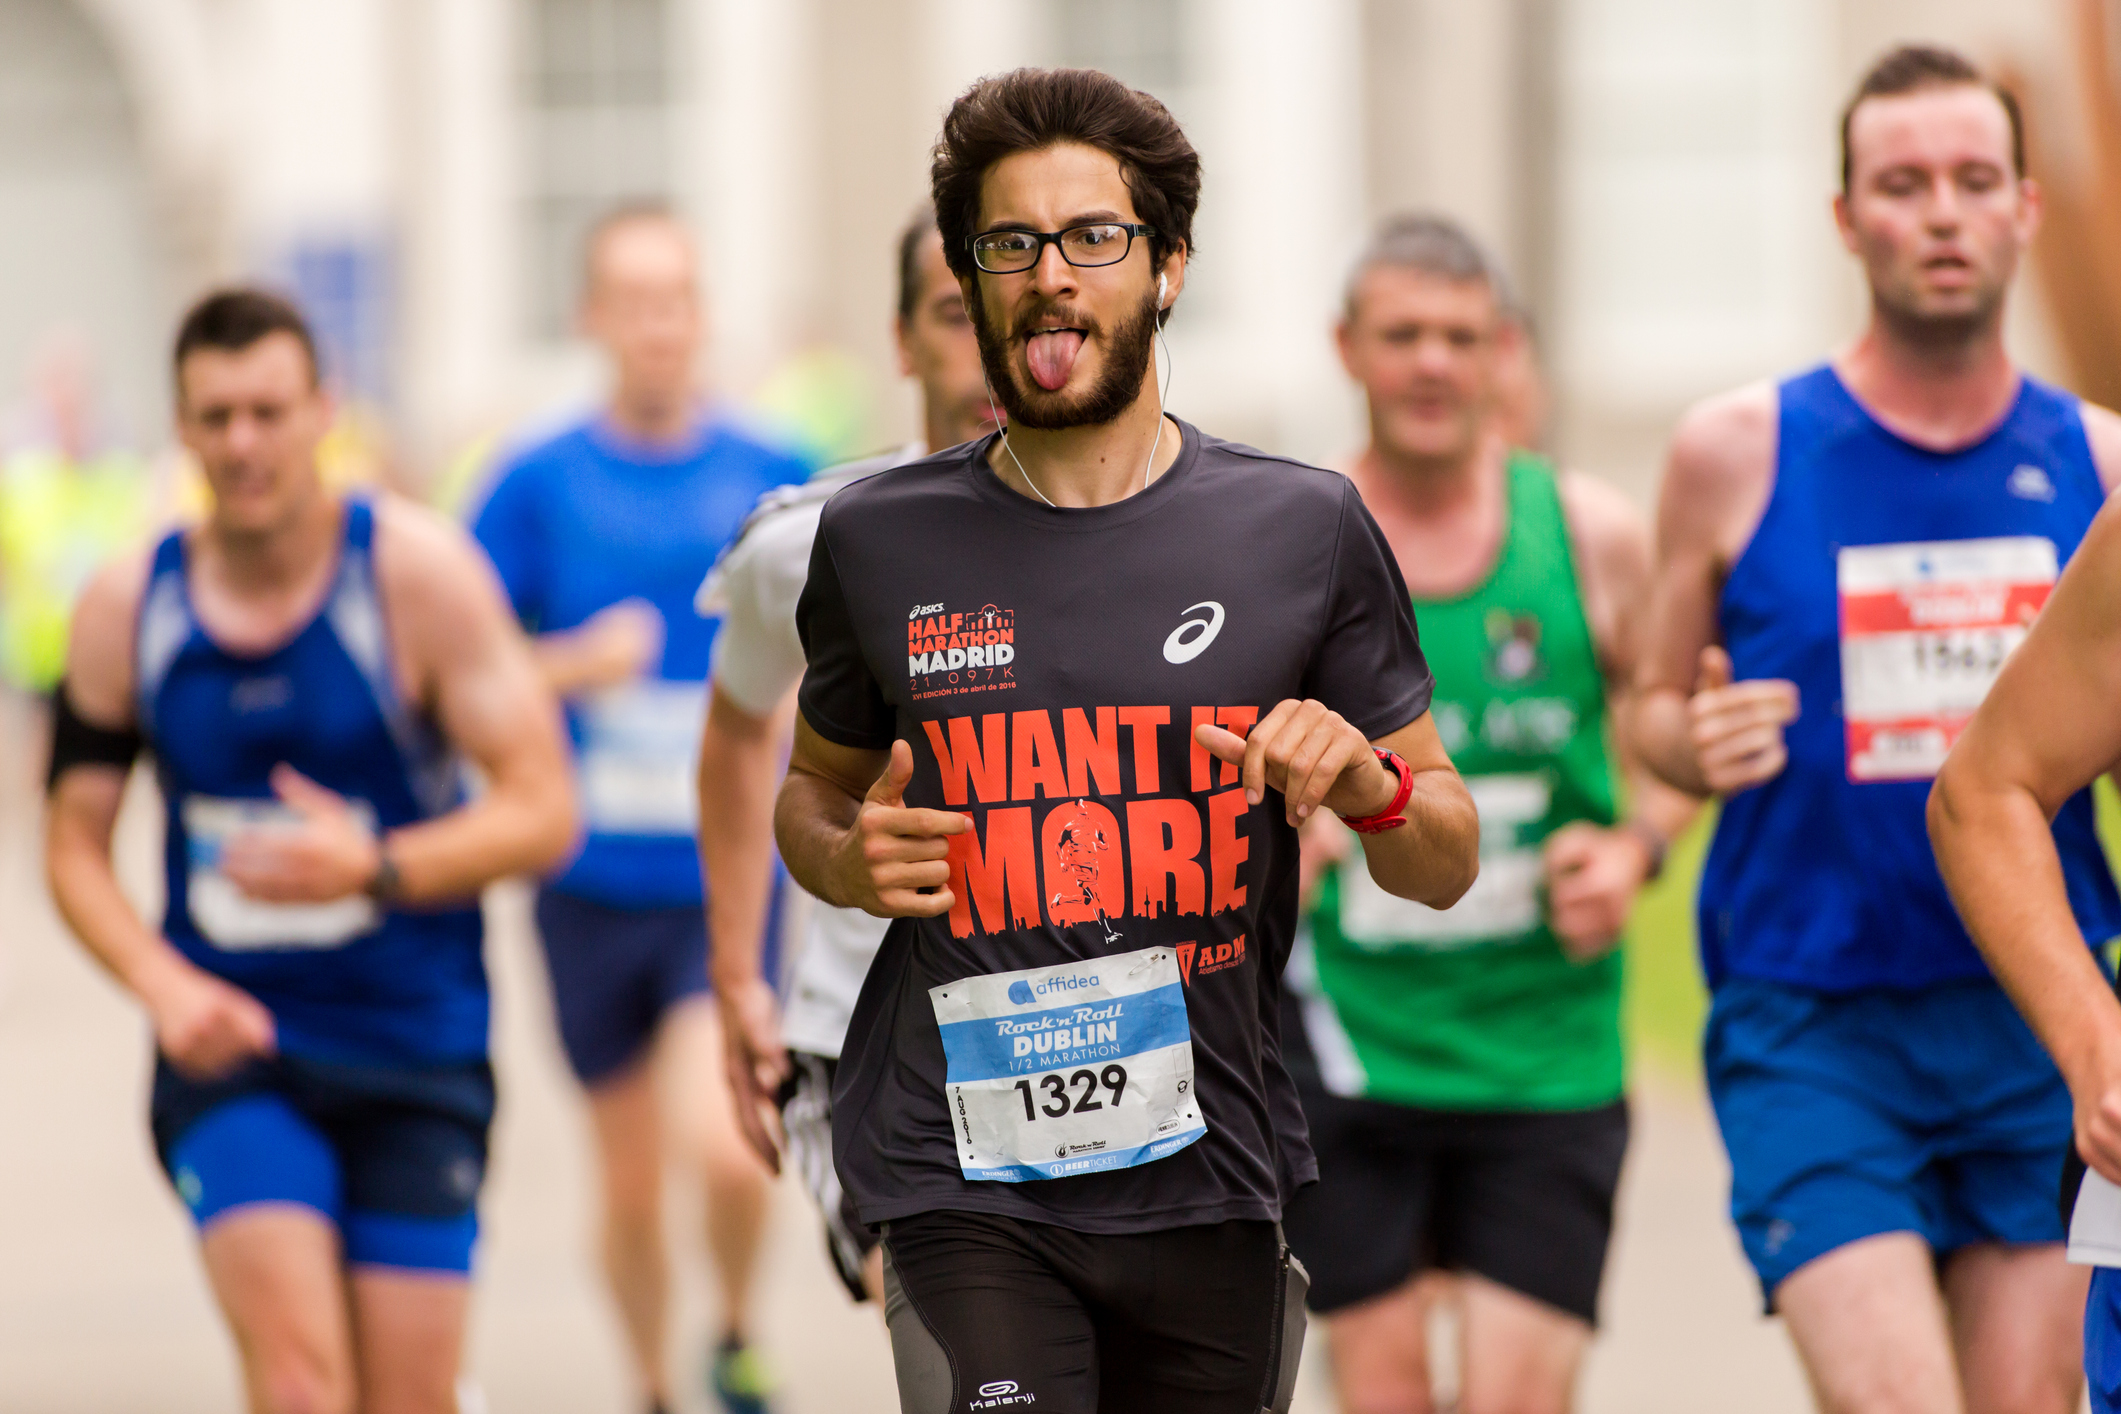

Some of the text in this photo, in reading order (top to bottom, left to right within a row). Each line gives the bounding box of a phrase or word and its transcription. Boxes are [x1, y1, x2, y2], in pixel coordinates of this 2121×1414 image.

[920, 603, 944, 615] asics
[908, 613, 963, 641] HALF
[908, 628, 1014, 656] MARATHON
[908, 644, 1015, 677] MADRID
[923, 688, 952, 698] EDICIÓN
[970, 684, 987, 692] abril
[921, 705, 1260, 805] WANT IT
[947, 788, 1250, 939] MORE
[1198, 933, 1246, 968] ADM
[1036, 974, 1100, 995] affidea
[1013, 1020, 1117, 1058] DUBLIN
[1008, 1043, 1121, 1072] 1/2 MARATHON
[1014, 1064, 1128, 1122] 1329
[955, 1086, 972, 1145] 7 AUG 2016
[1150, 1139, 1182, 1153] ERDINGER
[969, 1393, 1036, 1411] Kalenji
